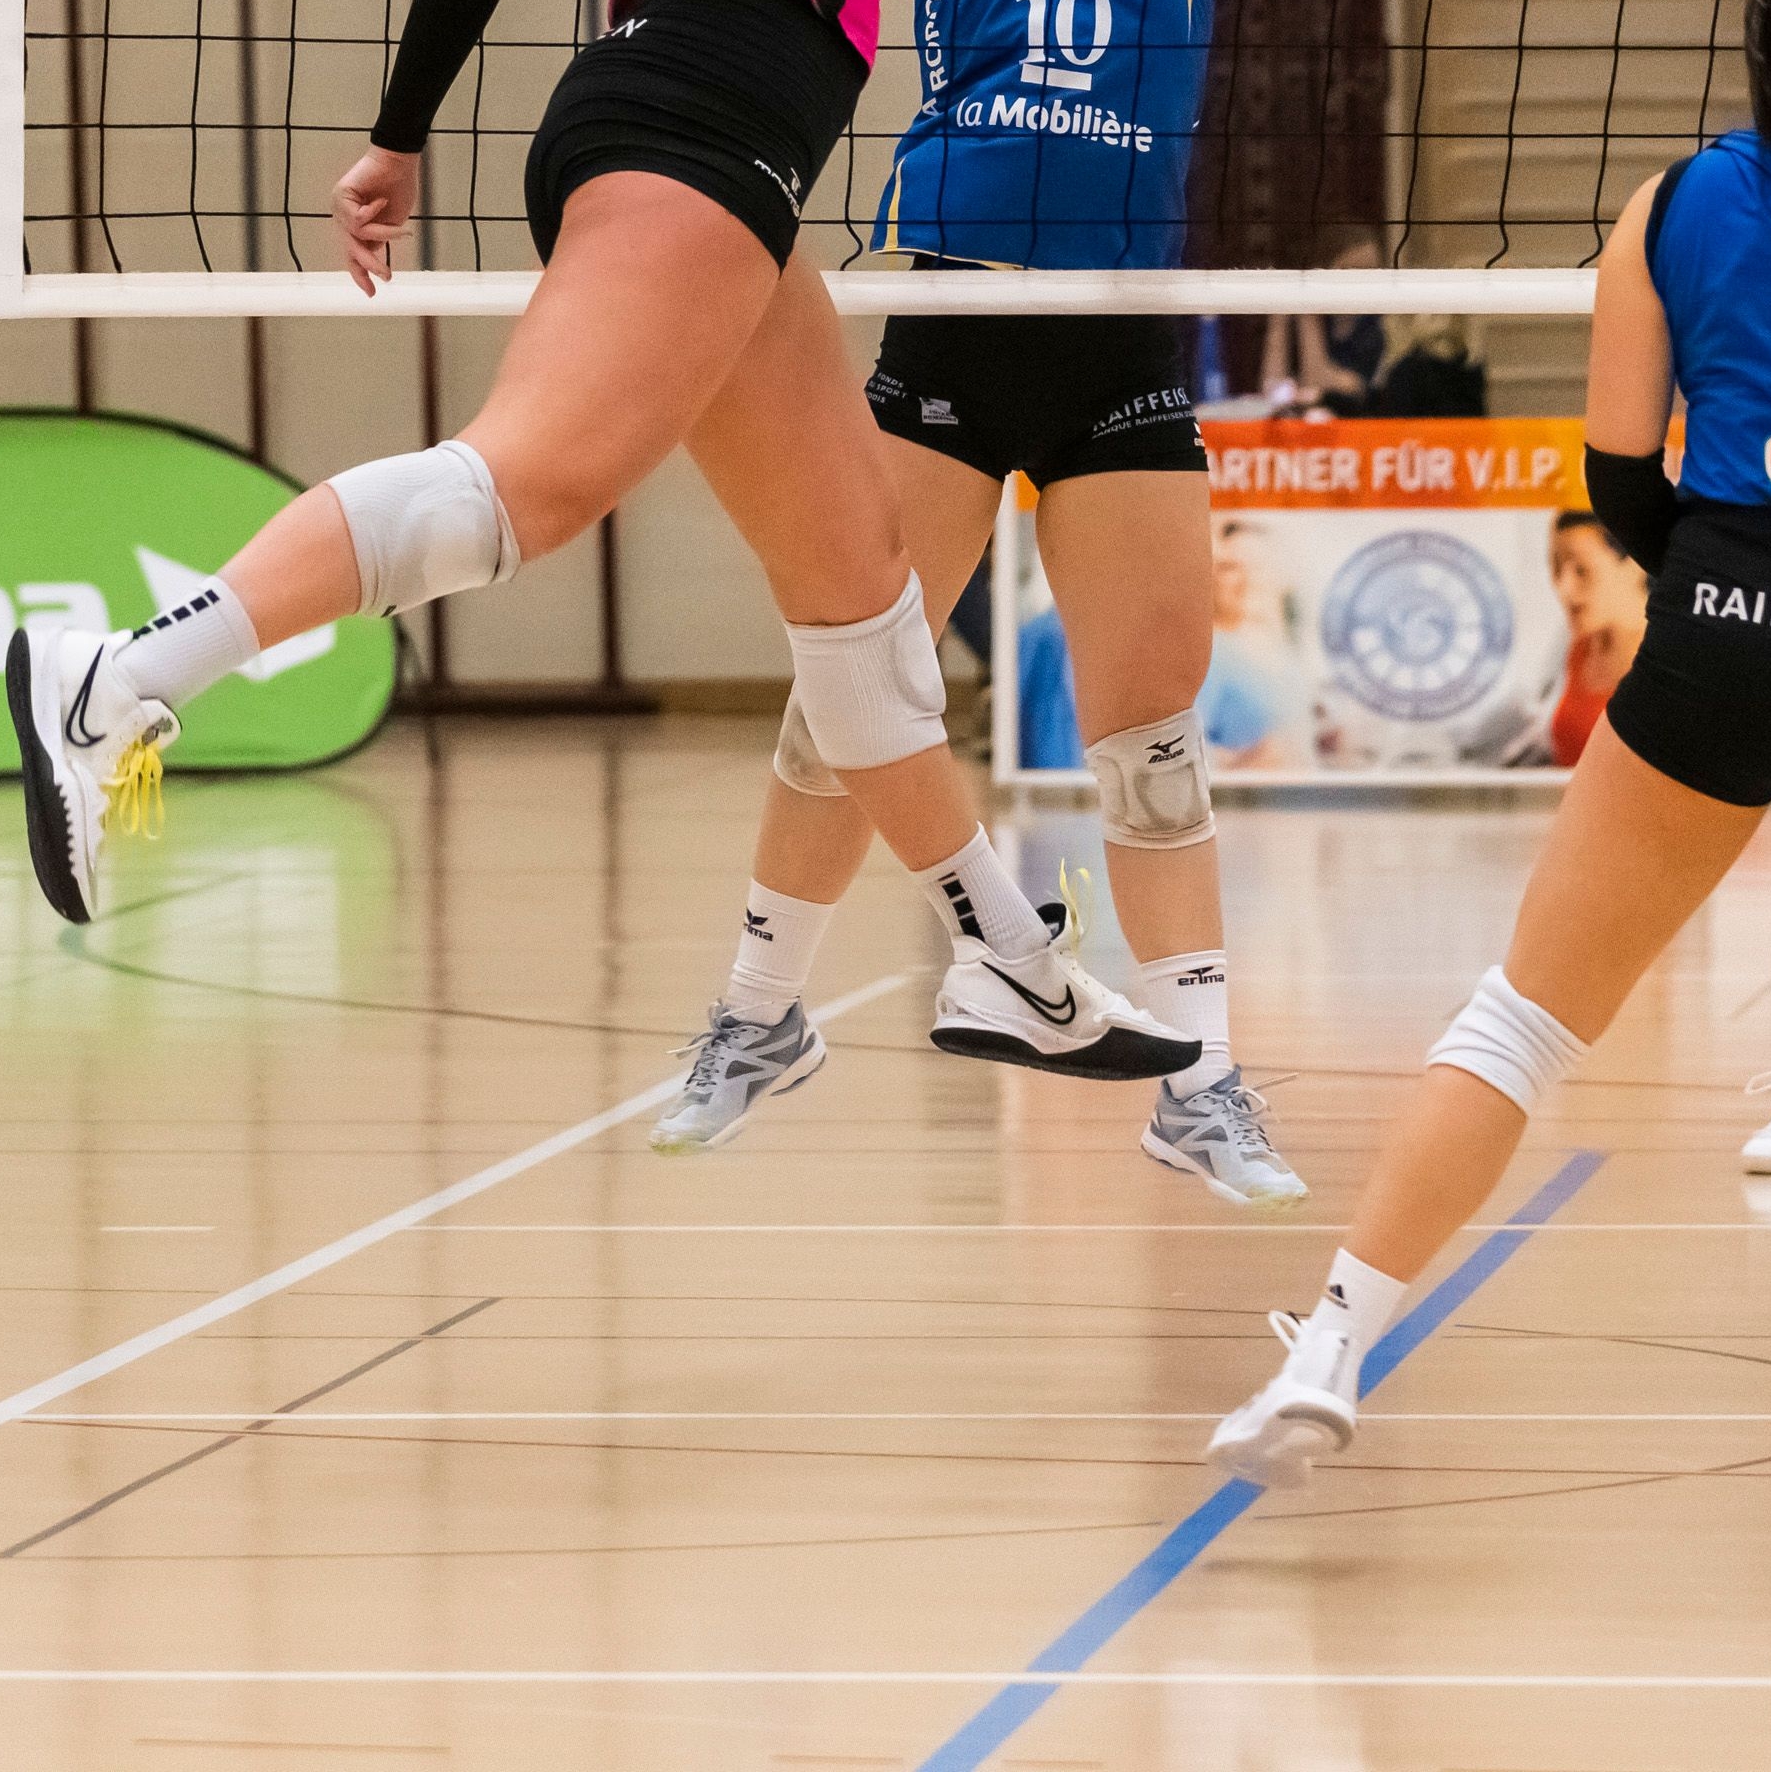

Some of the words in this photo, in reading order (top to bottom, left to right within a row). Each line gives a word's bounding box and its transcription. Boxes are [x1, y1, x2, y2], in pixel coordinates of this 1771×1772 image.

[956, 96, 984, 127] la
[988, 94, 1153, 152] Mobilière
[1208, 444, 1359, 495] ARTNER
[1374, 437, 1455, 493] FÜR
[1471, 445, 1568, 493] V.I.P.
